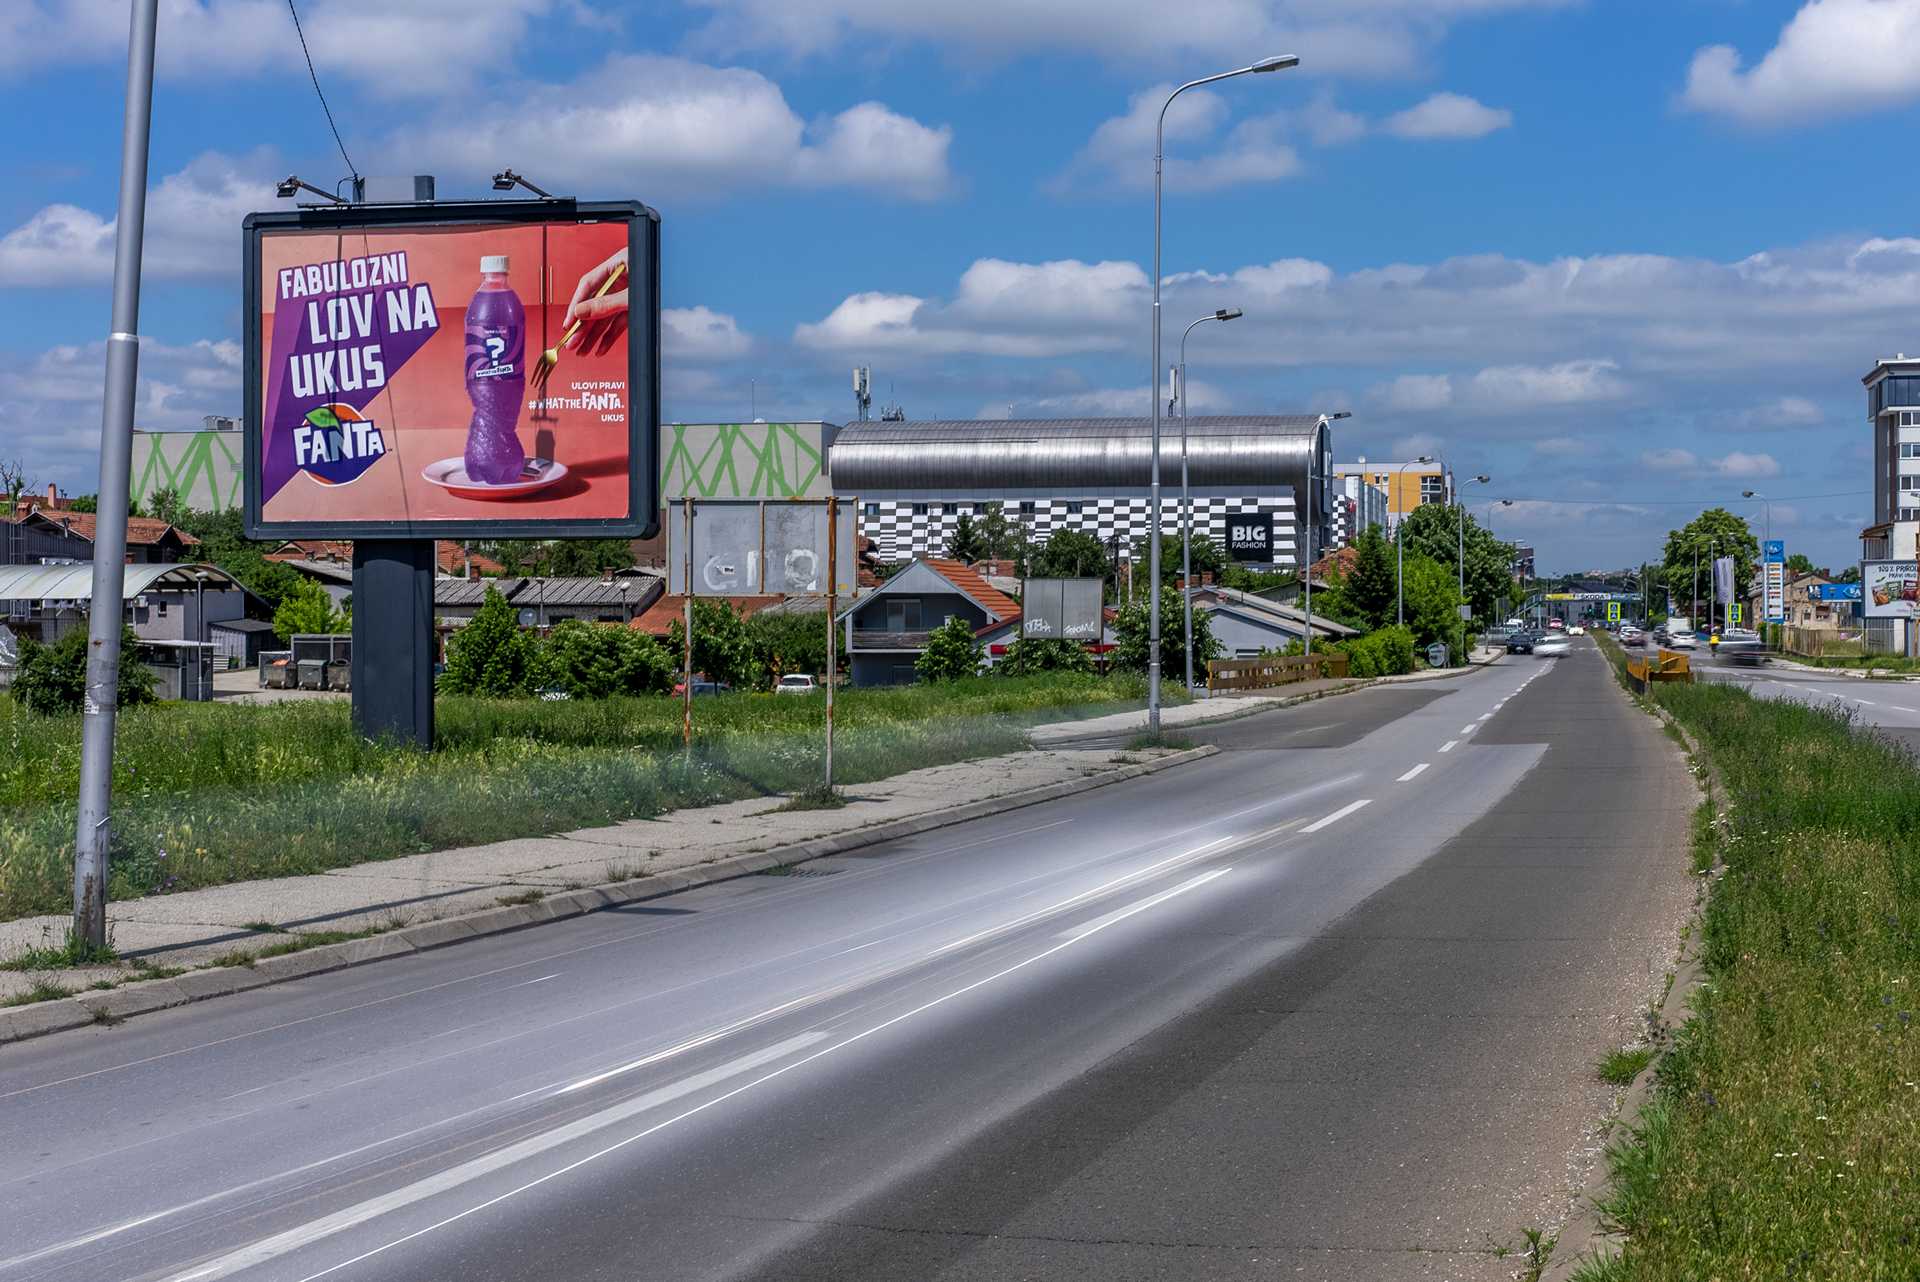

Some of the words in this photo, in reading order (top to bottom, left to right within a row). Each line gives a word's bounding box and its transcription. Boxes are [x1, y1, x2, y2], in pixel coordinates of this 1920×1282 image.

[280, 252, 408, 299] FABULOZNI
[308, 293, 374, 344] LOV
[386, 285, 438, 334] NA
[290, 344, 385, 398] UKUS
[571, 382, 598, 390] ULOVI
[599, 381, 625, 390] PRAVI
[601, 414, 625, 422] UKUS
[293, 421, 385, 466] FANTA
[1231, 525, 1266, 541] BIG
[1231, 541, 1266, 549] FASHION
